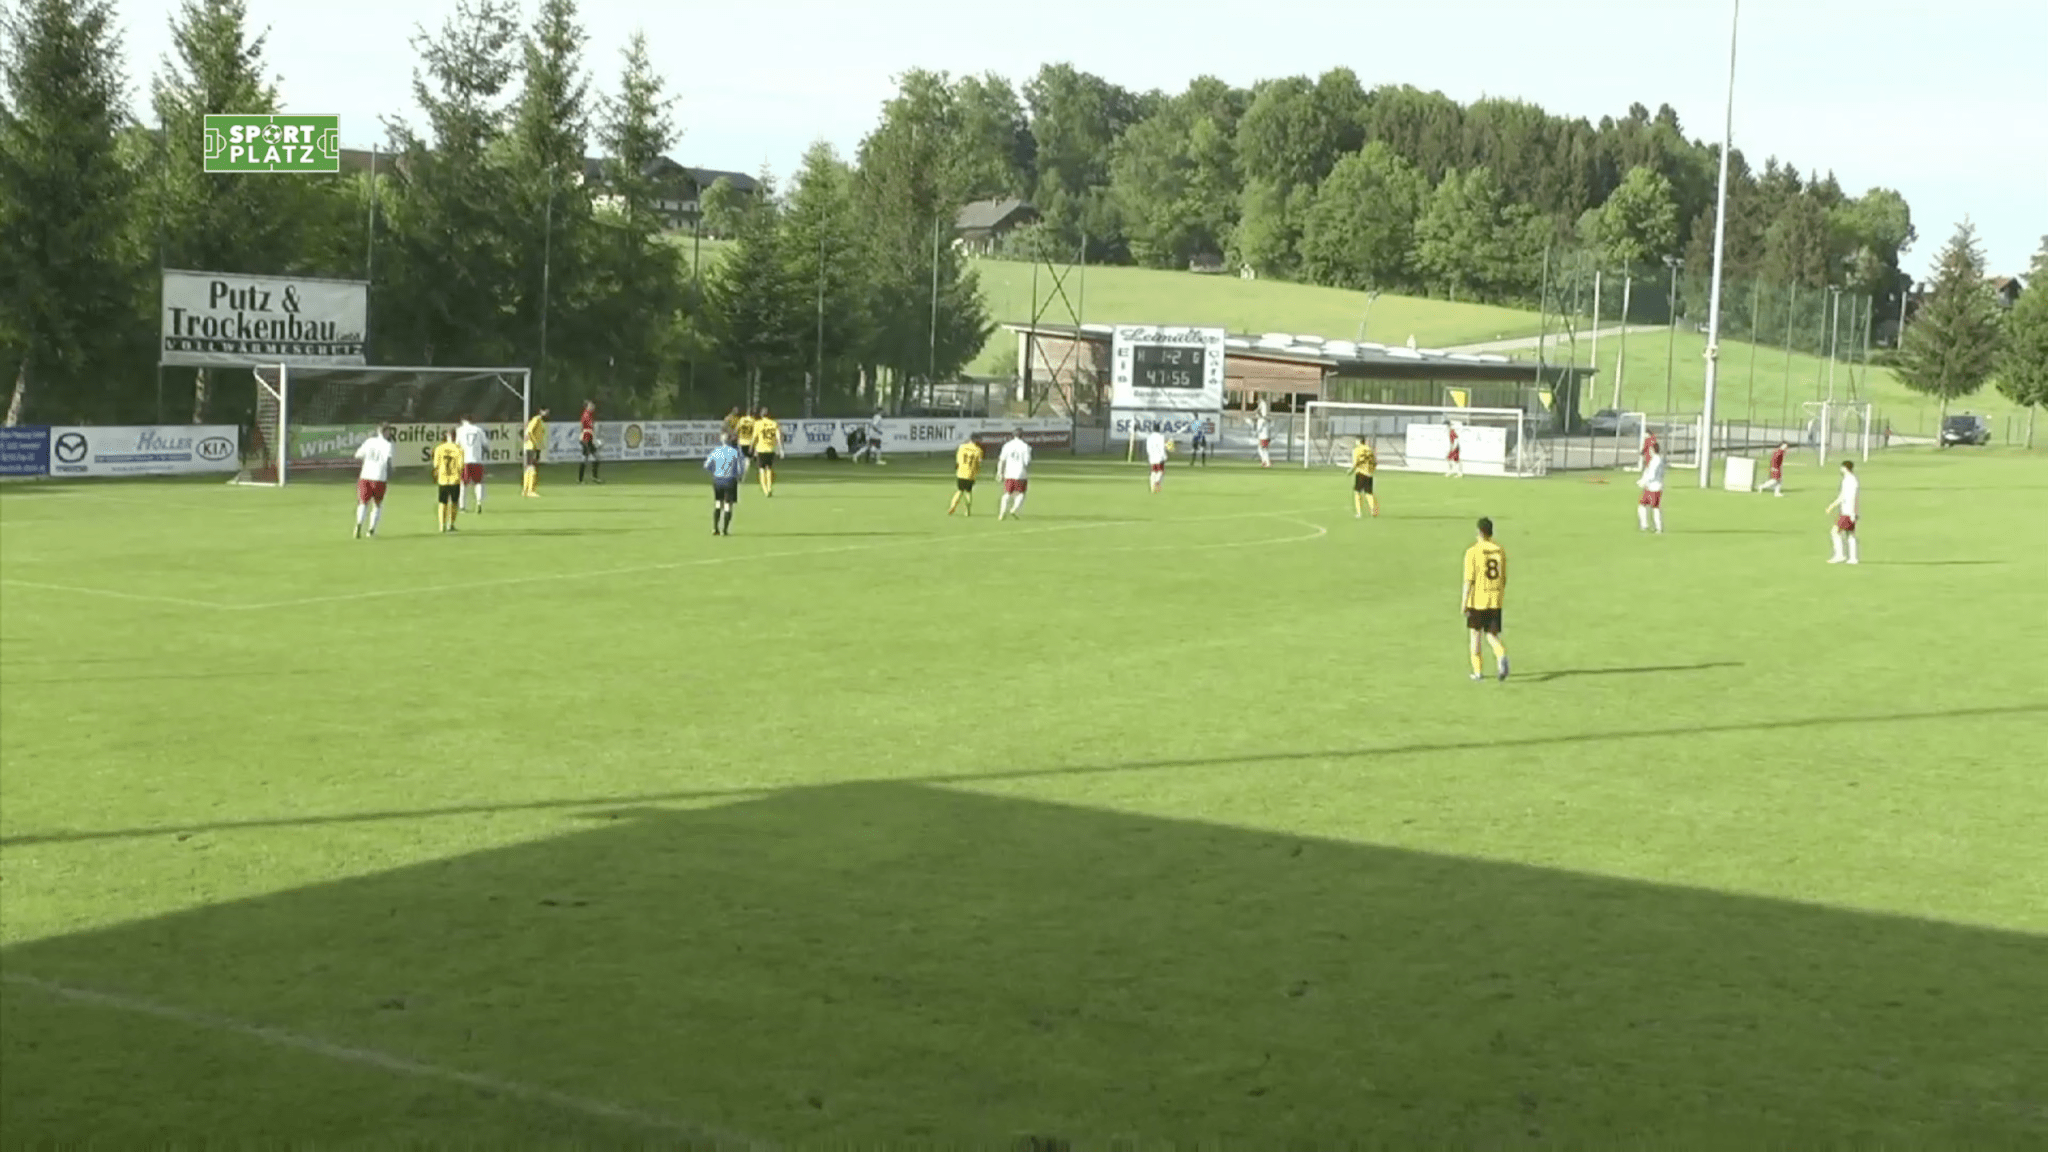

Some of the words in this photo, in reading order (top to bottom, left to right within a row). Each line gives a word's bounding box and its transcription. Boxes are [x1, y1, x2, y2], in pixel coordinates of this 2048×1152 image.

[209, 281, 273, 312] Putz
[281, 284, 301, 313] &
[168, 307, 335, 341] Trockenbau
[910, 424, 955, 441] BERNIT
[202, 442, 227, 456] KIA
[1485, 558, 1499, 580] 8
